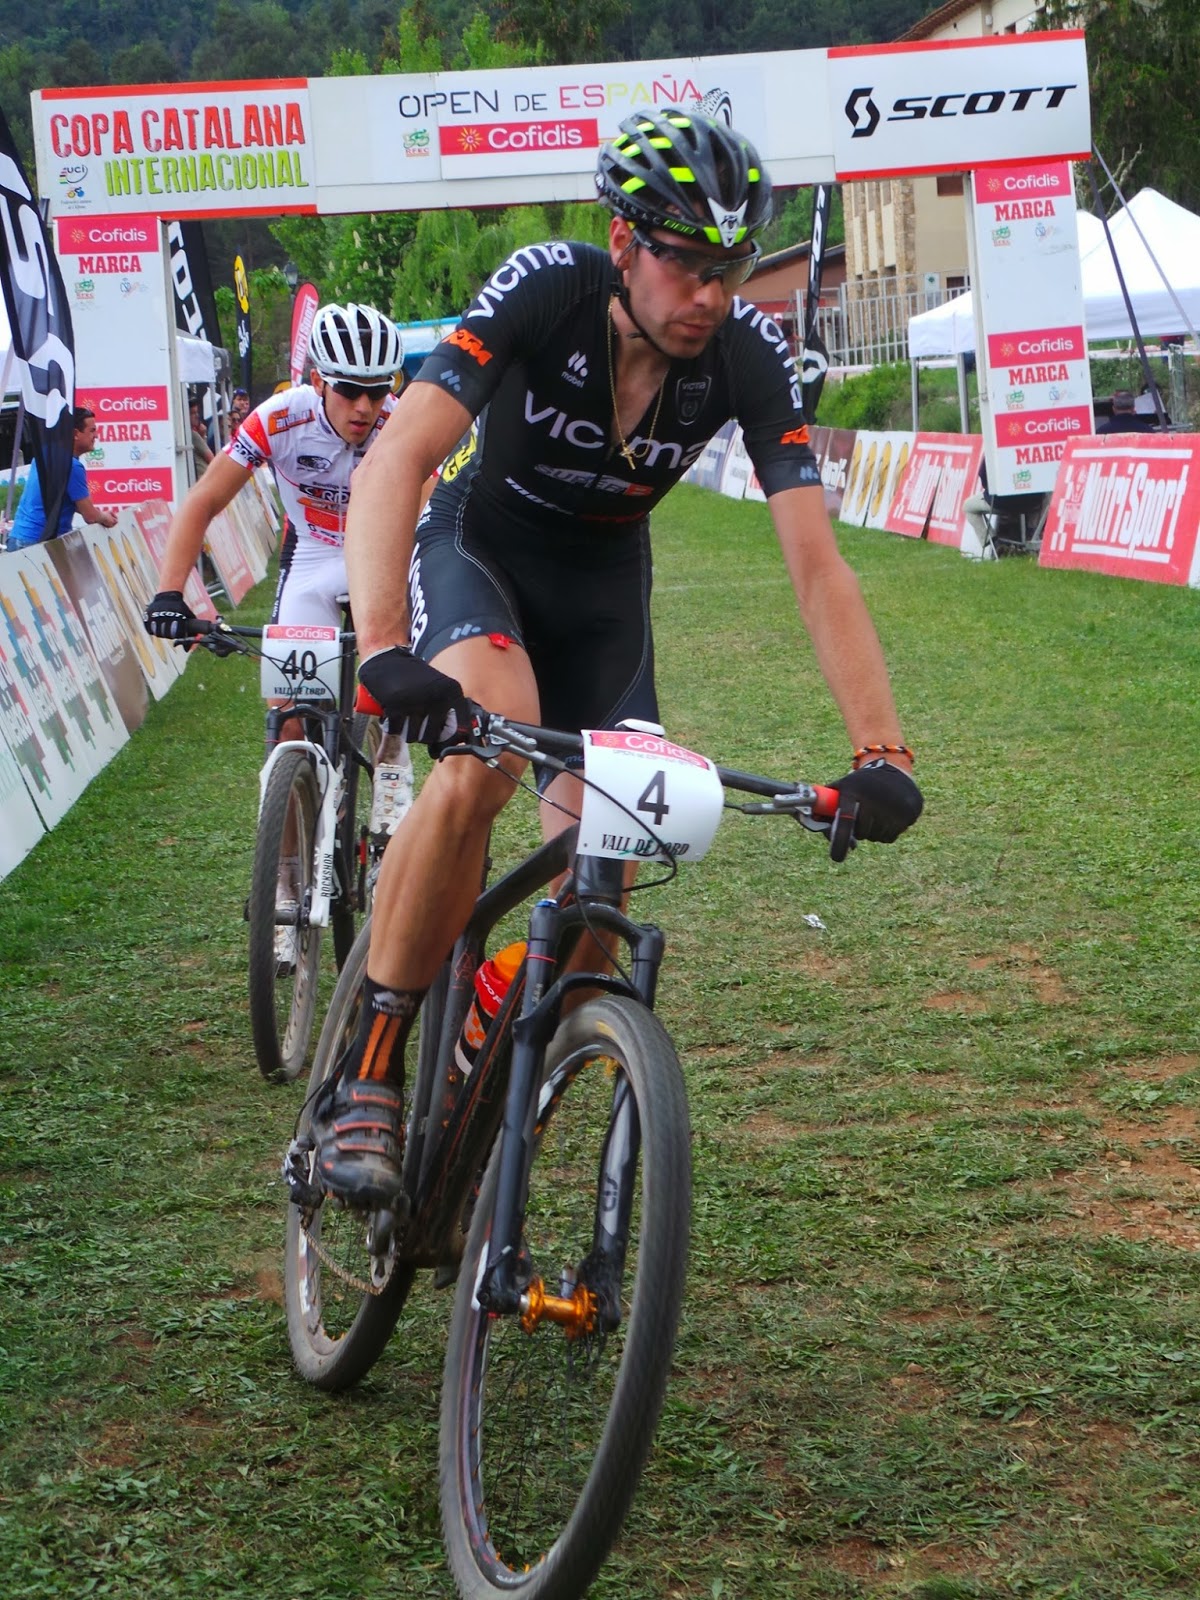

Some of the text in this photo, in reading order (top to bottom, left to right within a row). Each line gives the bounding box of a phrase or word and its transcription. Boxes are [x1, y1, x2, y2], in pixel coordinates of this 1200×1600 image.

[399, 75, 702, 118] OPEN DE ESPAÑA
[887, 84, 1078, 122] SCOTT
[50, 102, 306, 158] COPA CATALANA
[488, 123, 583, 149] Cofidis
[104, 150, 309, 197] INTERNACIONAL
[1004, 173, 1060, 190] Cofidis
[994, 200, 1056, 222] MARCA
[88, 228, 148, 243] Cofidis
[78, 255, 142, 274] MARCA
[467, 242, 575, 319] vicma
[1018, 337, 1074, 355] Cofidis
[1008, 364, 1070, 386] MARCA
[99, 397, 158, 411] Cofidis
[1024, 416, 1081, 434] Cofidis
[1016, 445, 1064, 465] MARC
[104, 479, 162, 493] Cofidis
[1074, 462, 1190, 559] NutriSport
[285, 627, 331, 640] Cofidis
[281, 649, 317, 681] 40
[624, 735, 702, 766] Cofidis
[636, 770, 670, 826] 4
[601, 833, 631, 851] VALL
[321, 852, 334, 898] ROCKSHOX
